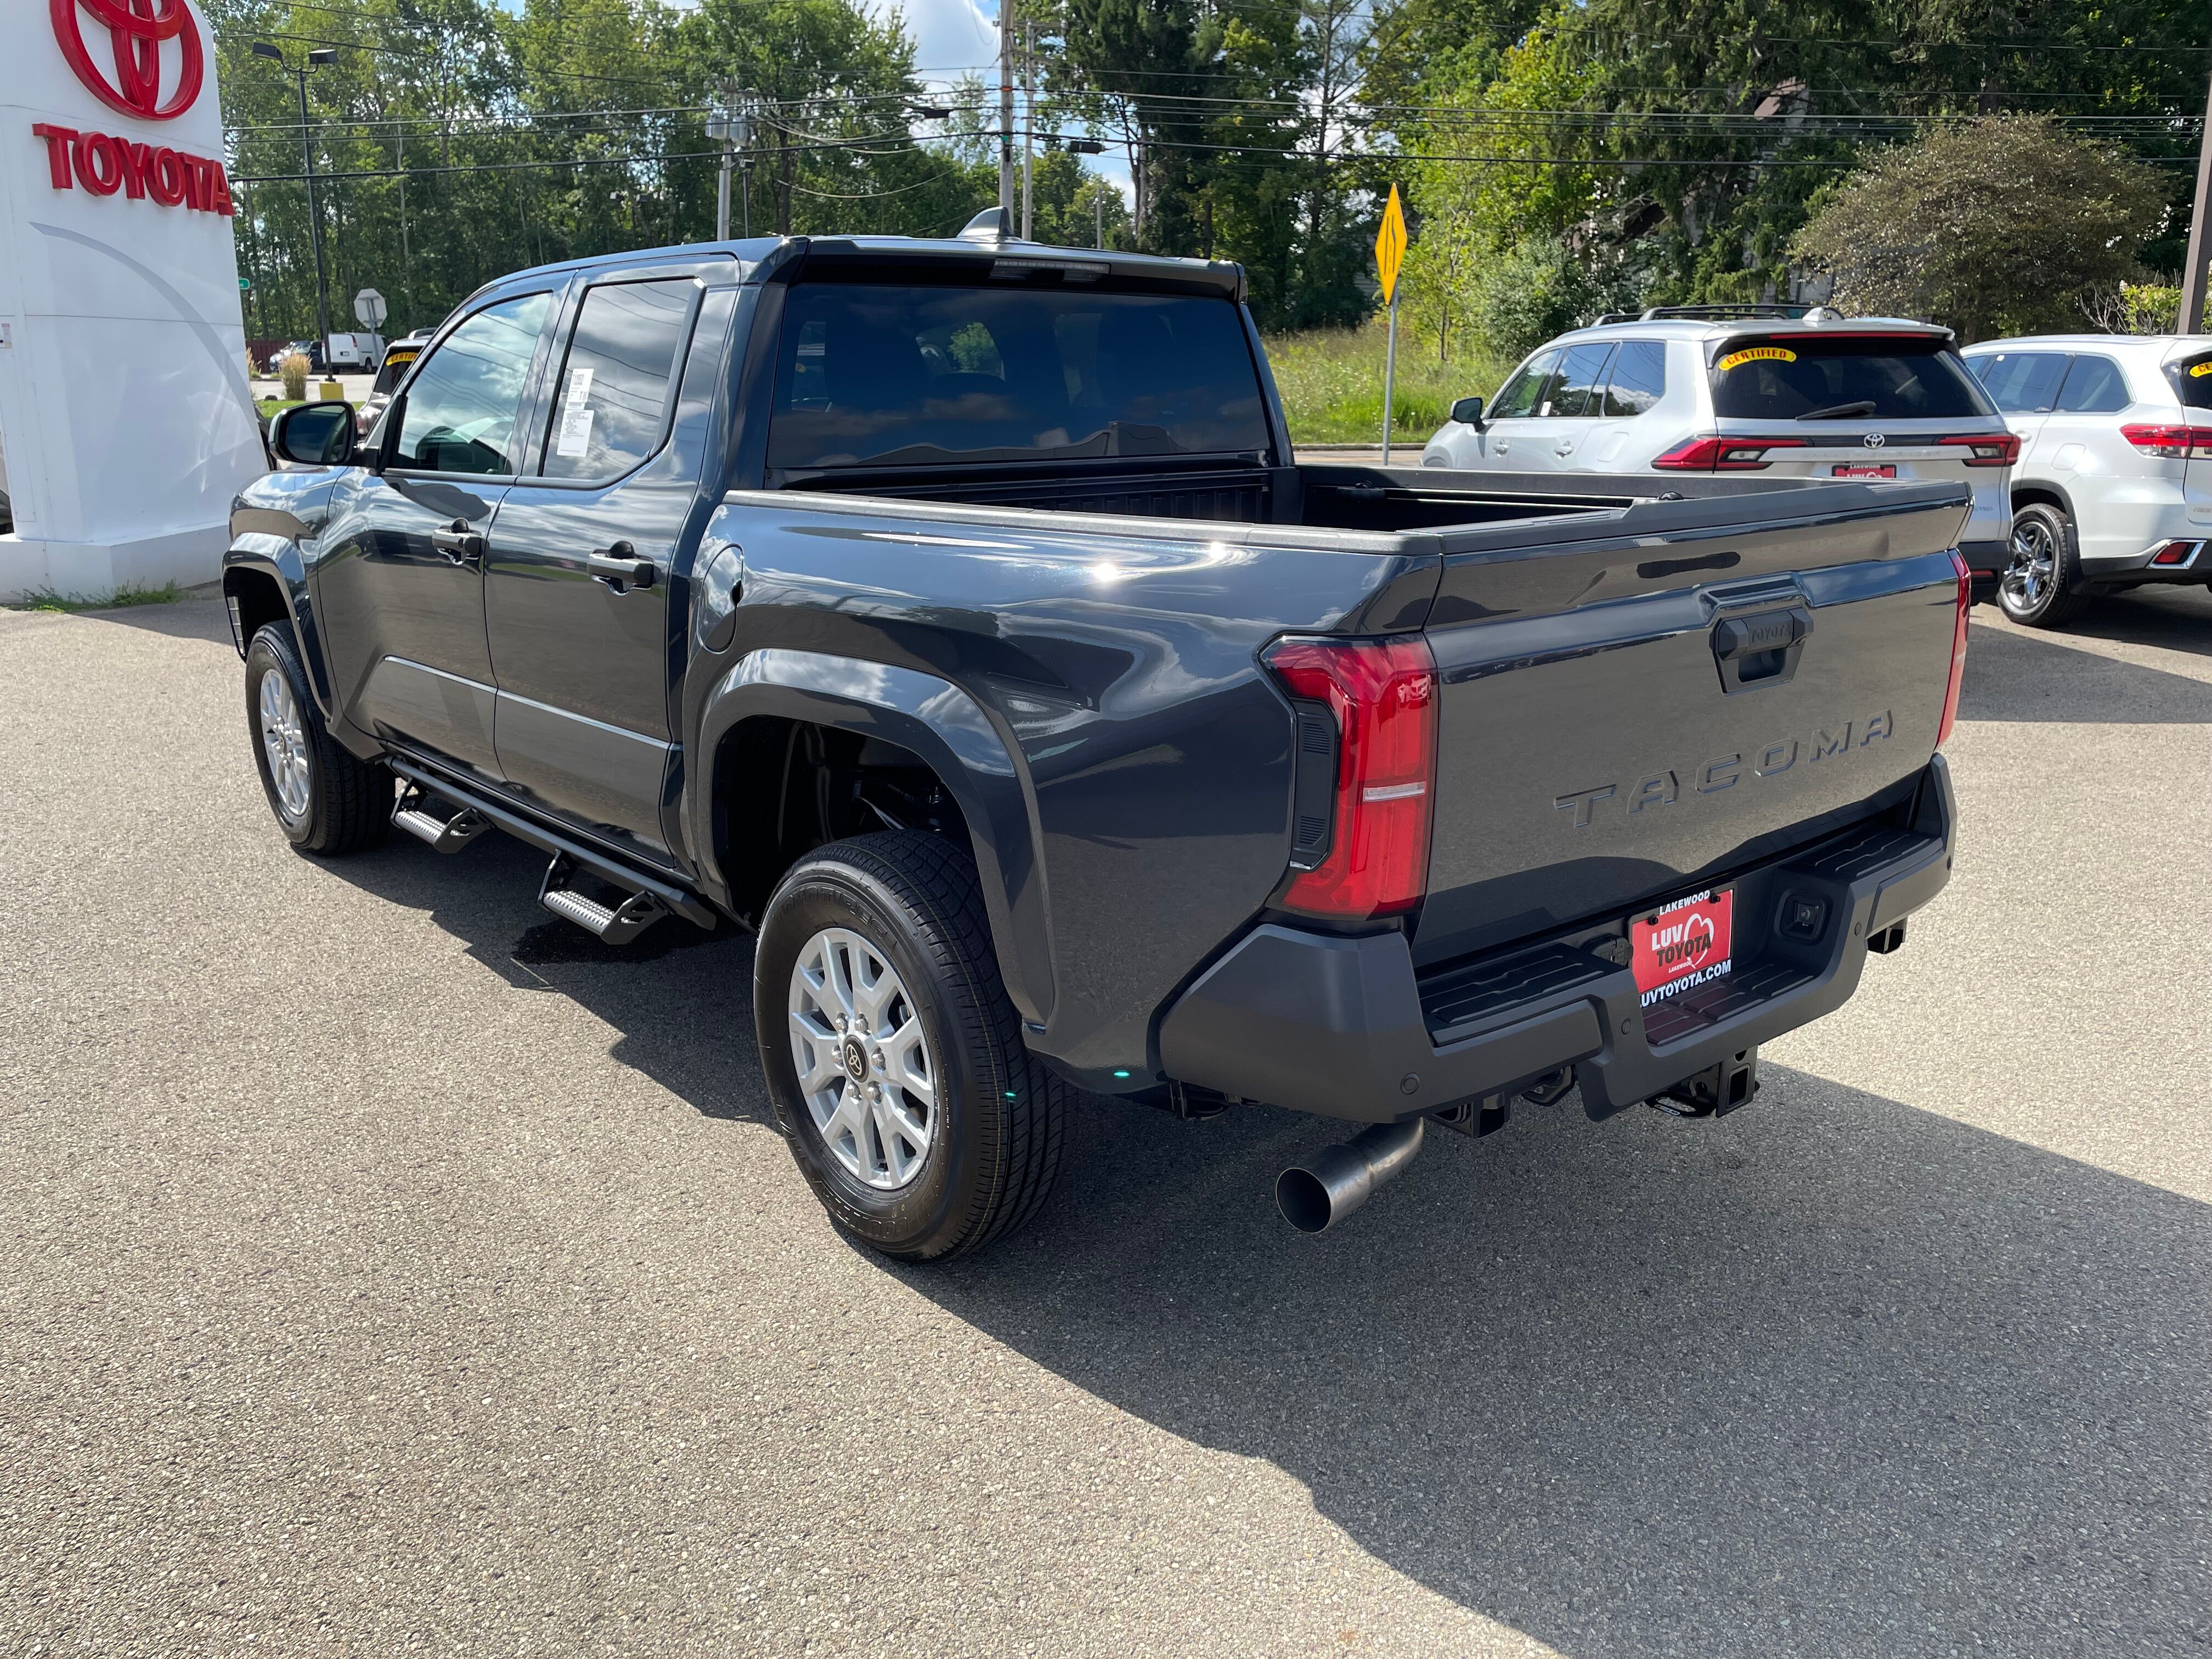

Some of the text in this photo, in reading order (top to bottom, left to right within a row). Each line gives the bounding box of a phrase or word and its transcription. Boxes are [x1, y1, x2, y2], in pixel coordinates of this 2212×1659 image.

[31, 122, 235, 216] TOYOTA
[1726, 349, 1787, 365] CERTIFIED
[1749, 623, 1792, 643] TOYOTA
[1553, 709, 1894, 827] TACOMA
[1658, 889, 1711, 916] LAKEWOOD
[1651, 923, 1684, 951] LUV
[1656, 933, 1712, 967] TOYOTA
[1668, 960, 1693, 973] LAKEWOOD
[1640, 959, 1731, 1008] UVTOYOTA.COM
